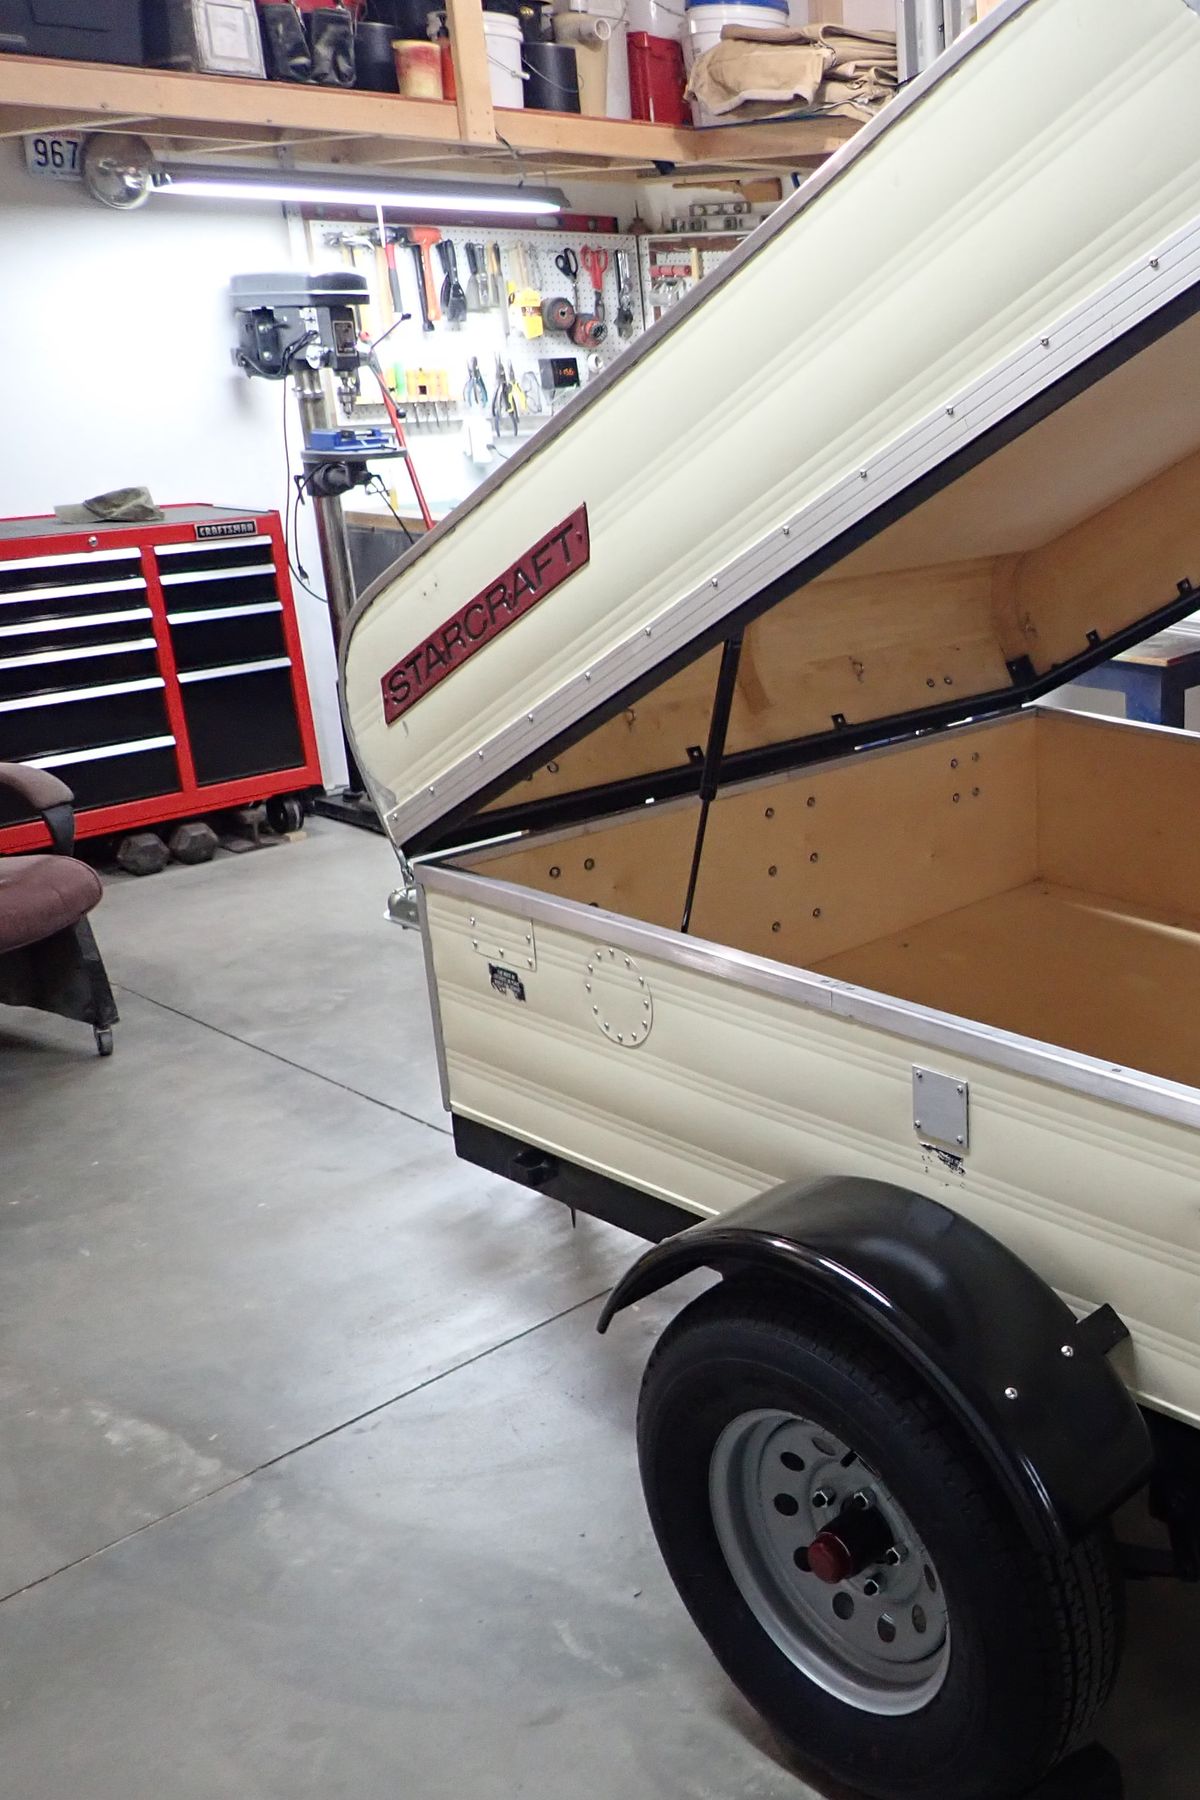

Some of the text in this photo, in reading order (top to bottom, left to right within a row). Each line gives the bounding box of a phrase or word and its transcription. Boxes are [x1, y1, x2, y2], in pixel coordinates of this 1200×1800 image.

[34, 138, 79, 169] 967
[199, 522, 255, 537] CRAFTSMAN
[388, 522, 574, 705] STARCRAFT
